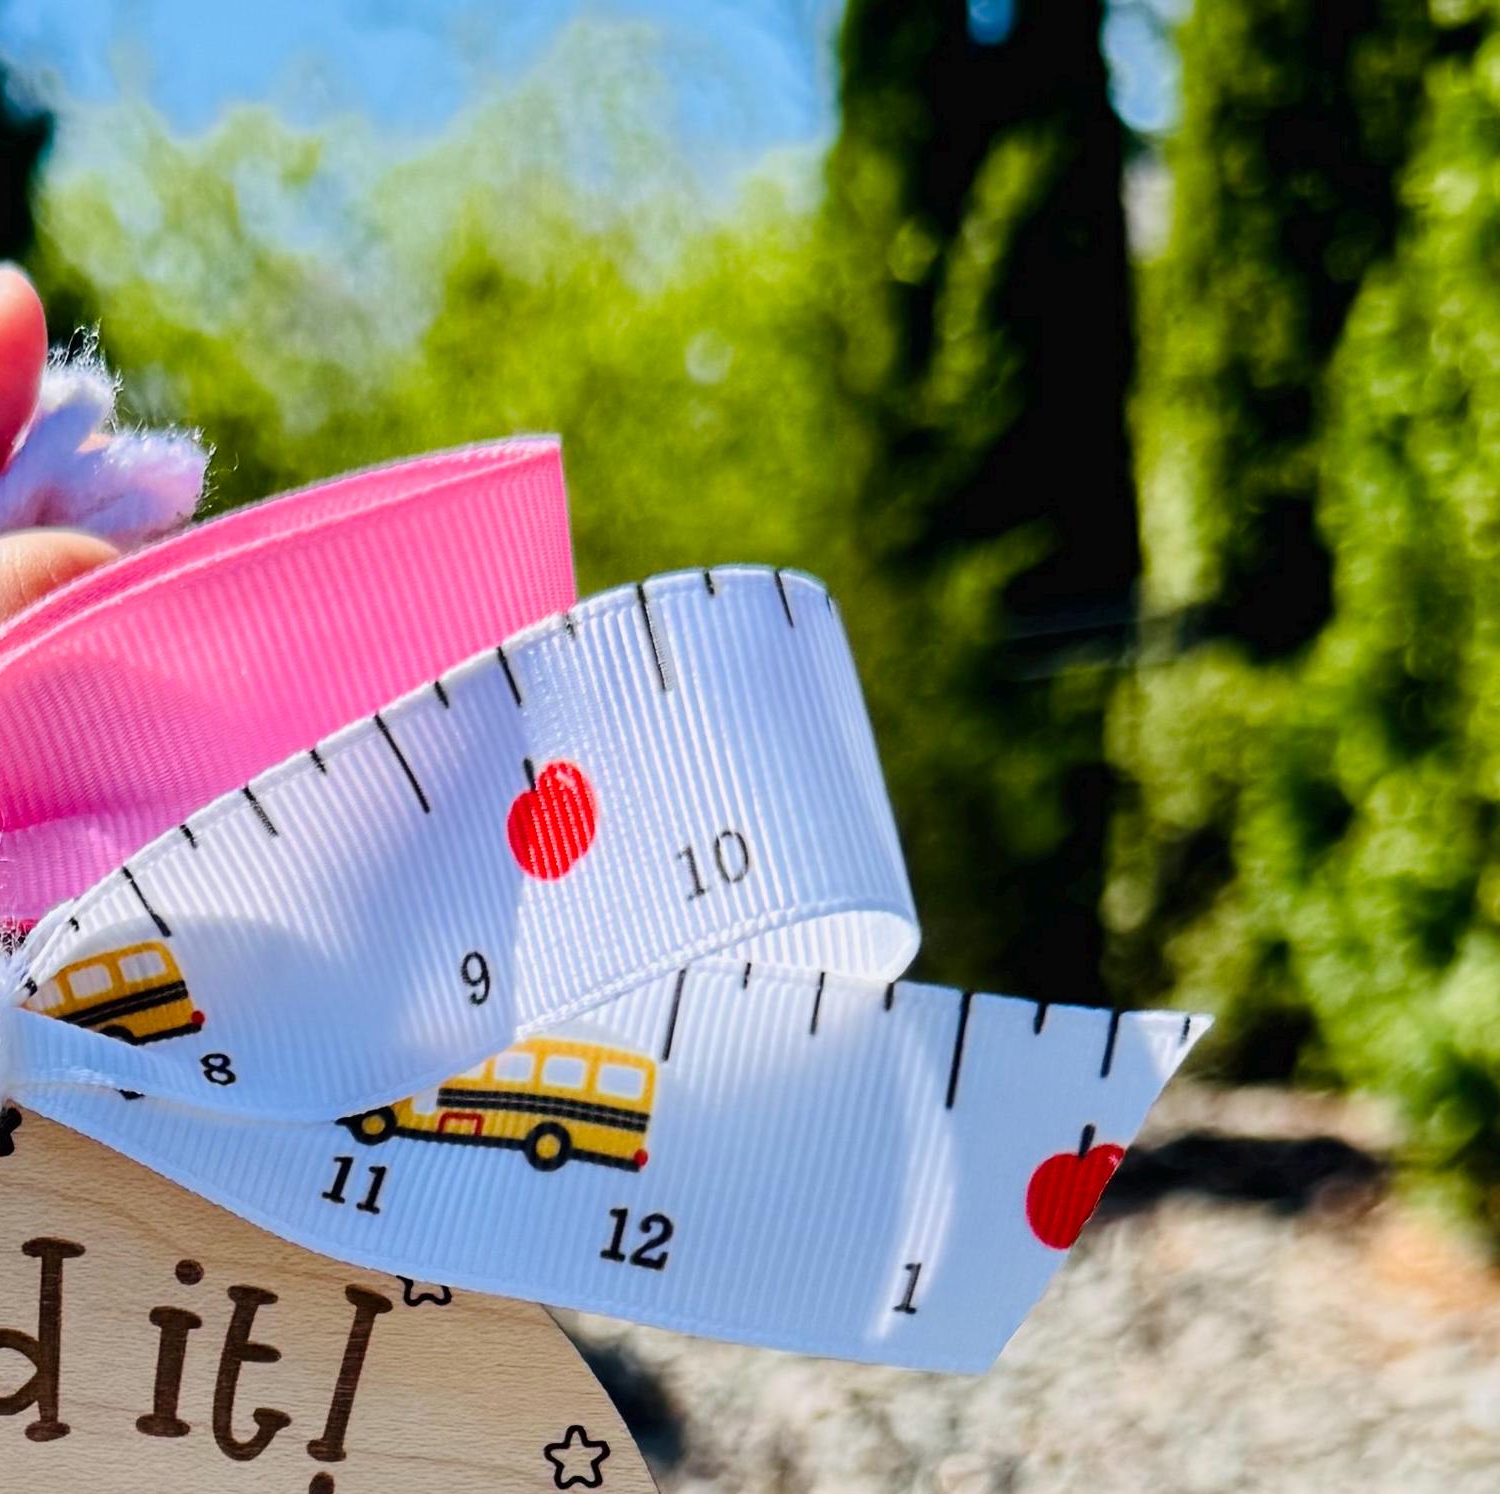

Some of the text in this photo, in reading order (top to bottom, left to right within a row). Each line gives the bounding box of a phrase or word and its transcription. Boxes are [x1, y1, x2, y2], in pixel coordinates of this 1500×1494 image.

[200, 829, 750, 1086] 8 9 10
[321, 1155, 922, 1315] 11 12 1
